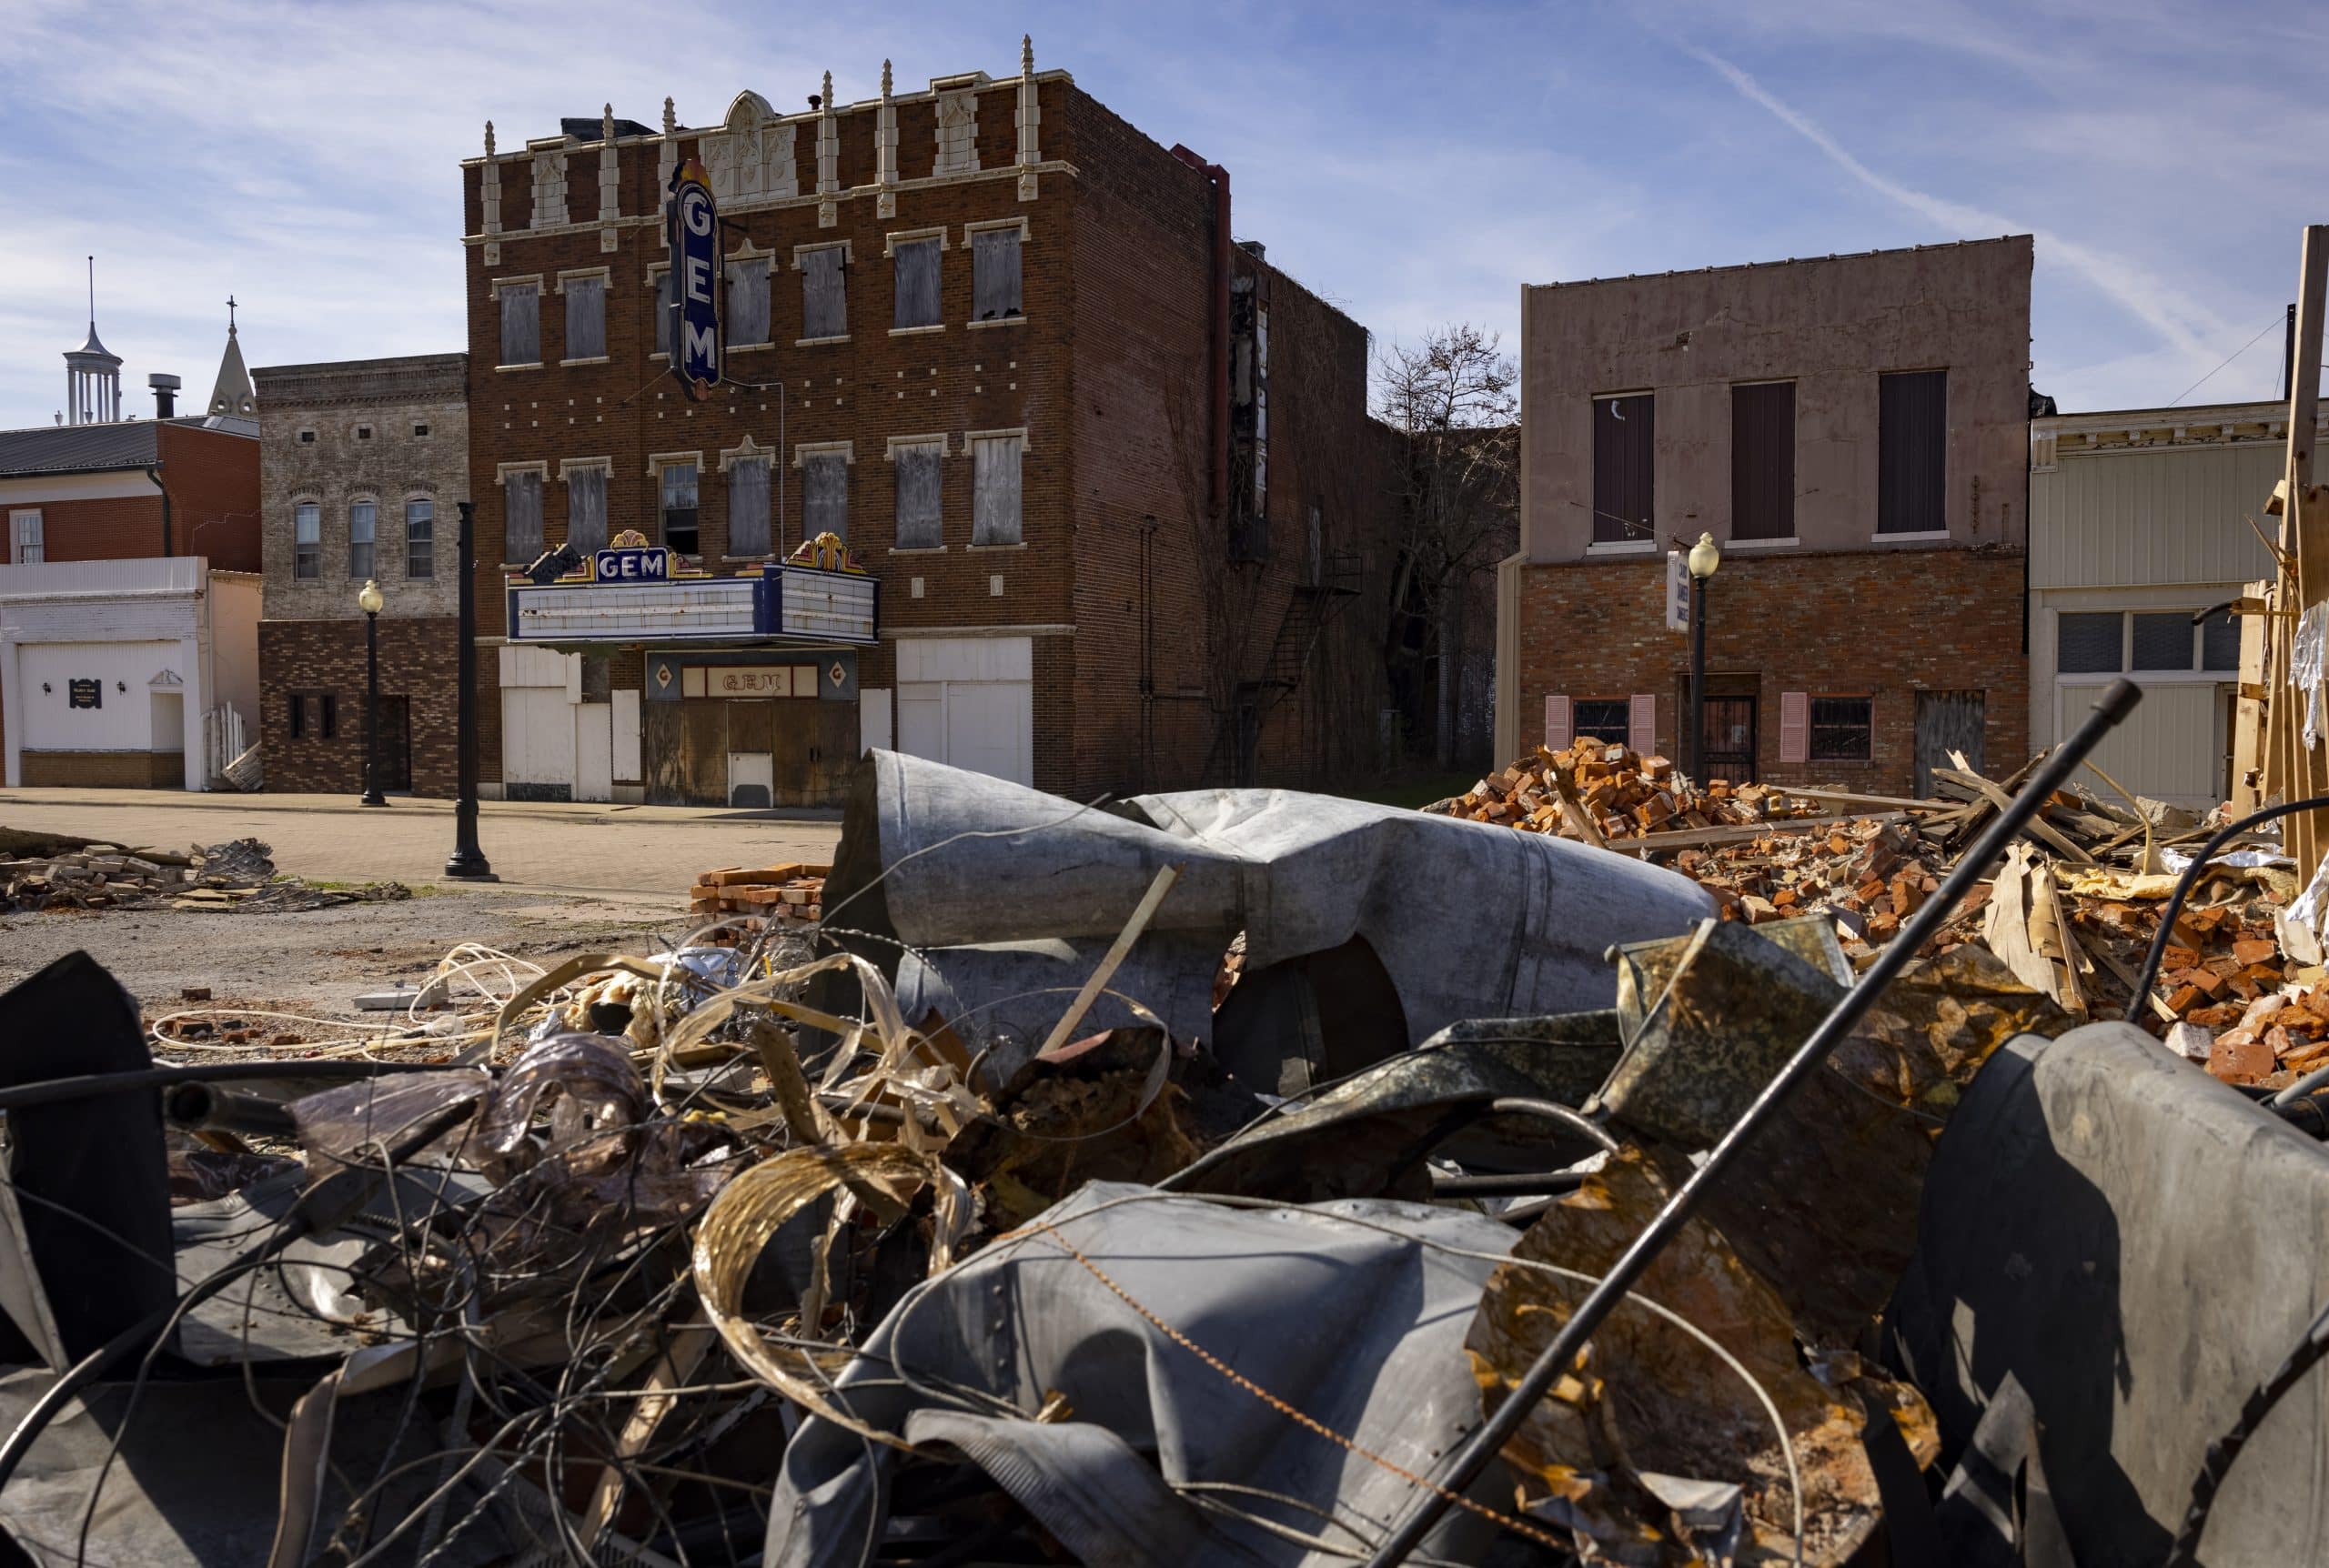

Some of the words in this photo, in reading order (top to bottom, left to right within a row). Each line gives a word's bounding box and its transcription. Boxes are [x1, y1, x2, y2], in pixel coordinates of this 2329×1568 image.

[683, 192, 715, 368] GEM
[600, 554, 663, 578] GEM
[660, 669, 669, 680] G
[832, 668, 842, 679] G
[722, 674, 781, 691] GEM
